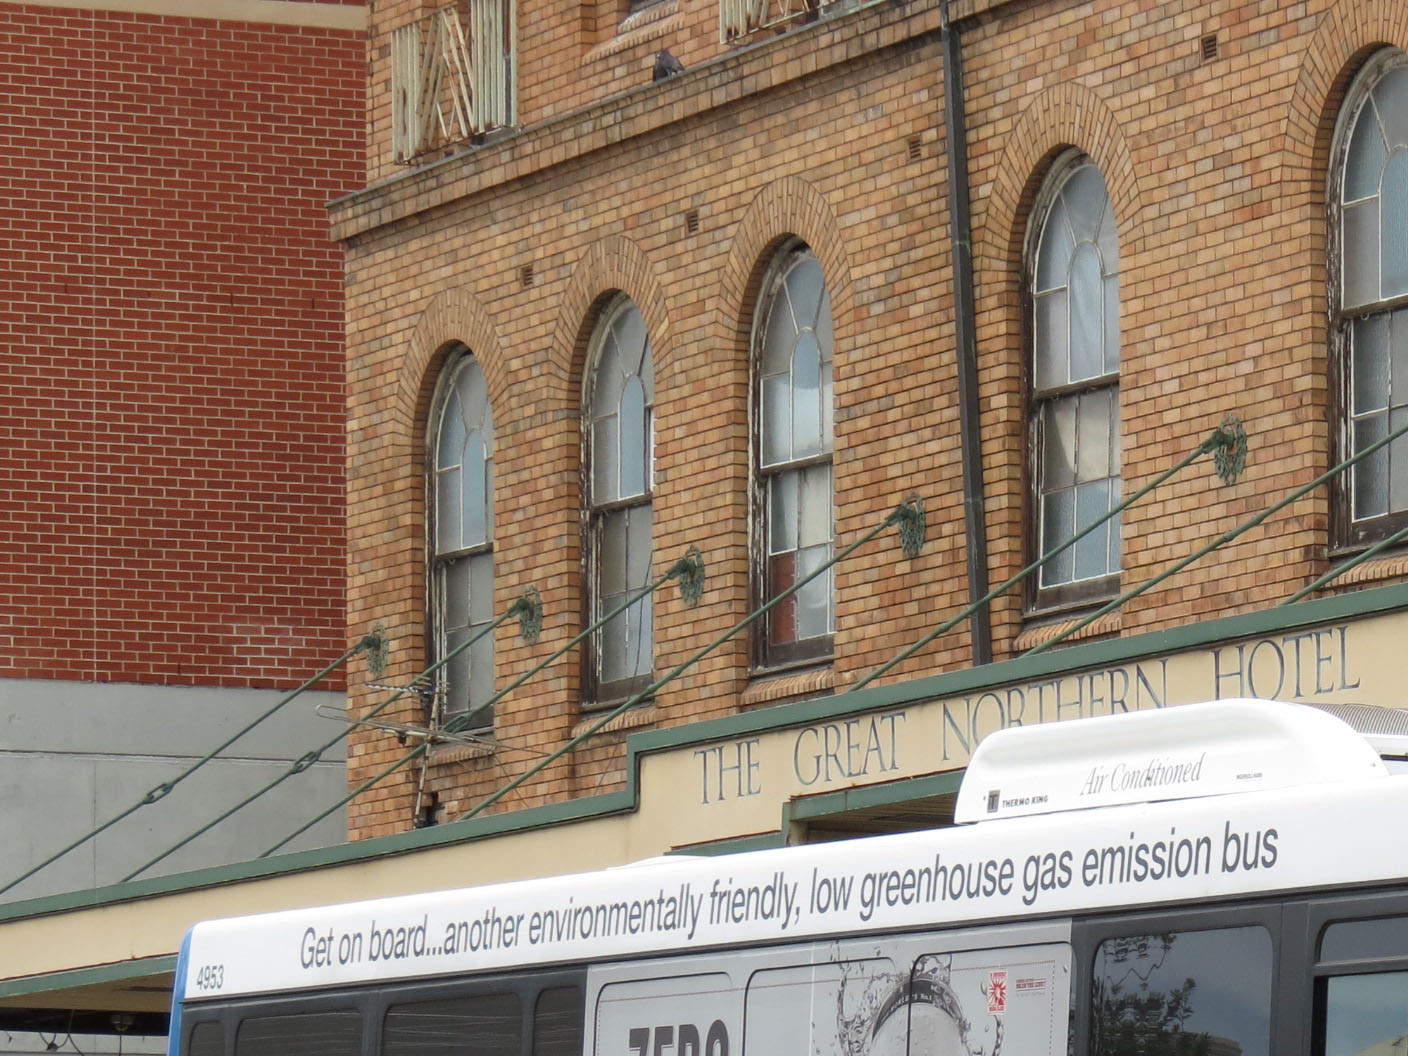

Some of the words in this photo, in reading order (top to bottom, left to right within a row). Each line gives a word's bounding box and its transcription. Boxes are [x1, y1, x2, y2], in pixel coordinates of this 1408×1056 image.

[694, 738, 762, 804] THE
[793, 711, 906, 786] GREAT
[942, 657, 1169, 761] NORTHERN
[1211, 626, 1361, 700] HOTEL
[1079, 765, 1109, 796] Air
[1110, 752, 1207, 792] Conditioned
[1002, 797, 1030, 809] THERMO
[1031, 795, 1049, 805] KING
[300, 927, 334, 970] Get
[338, 931, 363, 965] on
[528, 883, 704, 945] environmentally
[708, 871, 800, 930] friendly,
[808, 867, 854, 915] low
[859, 853, 1015, 922] greenhouse
[1022, 849, 1074, 906] gas
[1081, 825, 1212, 887] emission
[1221, 820, 1279, 873] bus
[196, 964, 225, 991] 4953
